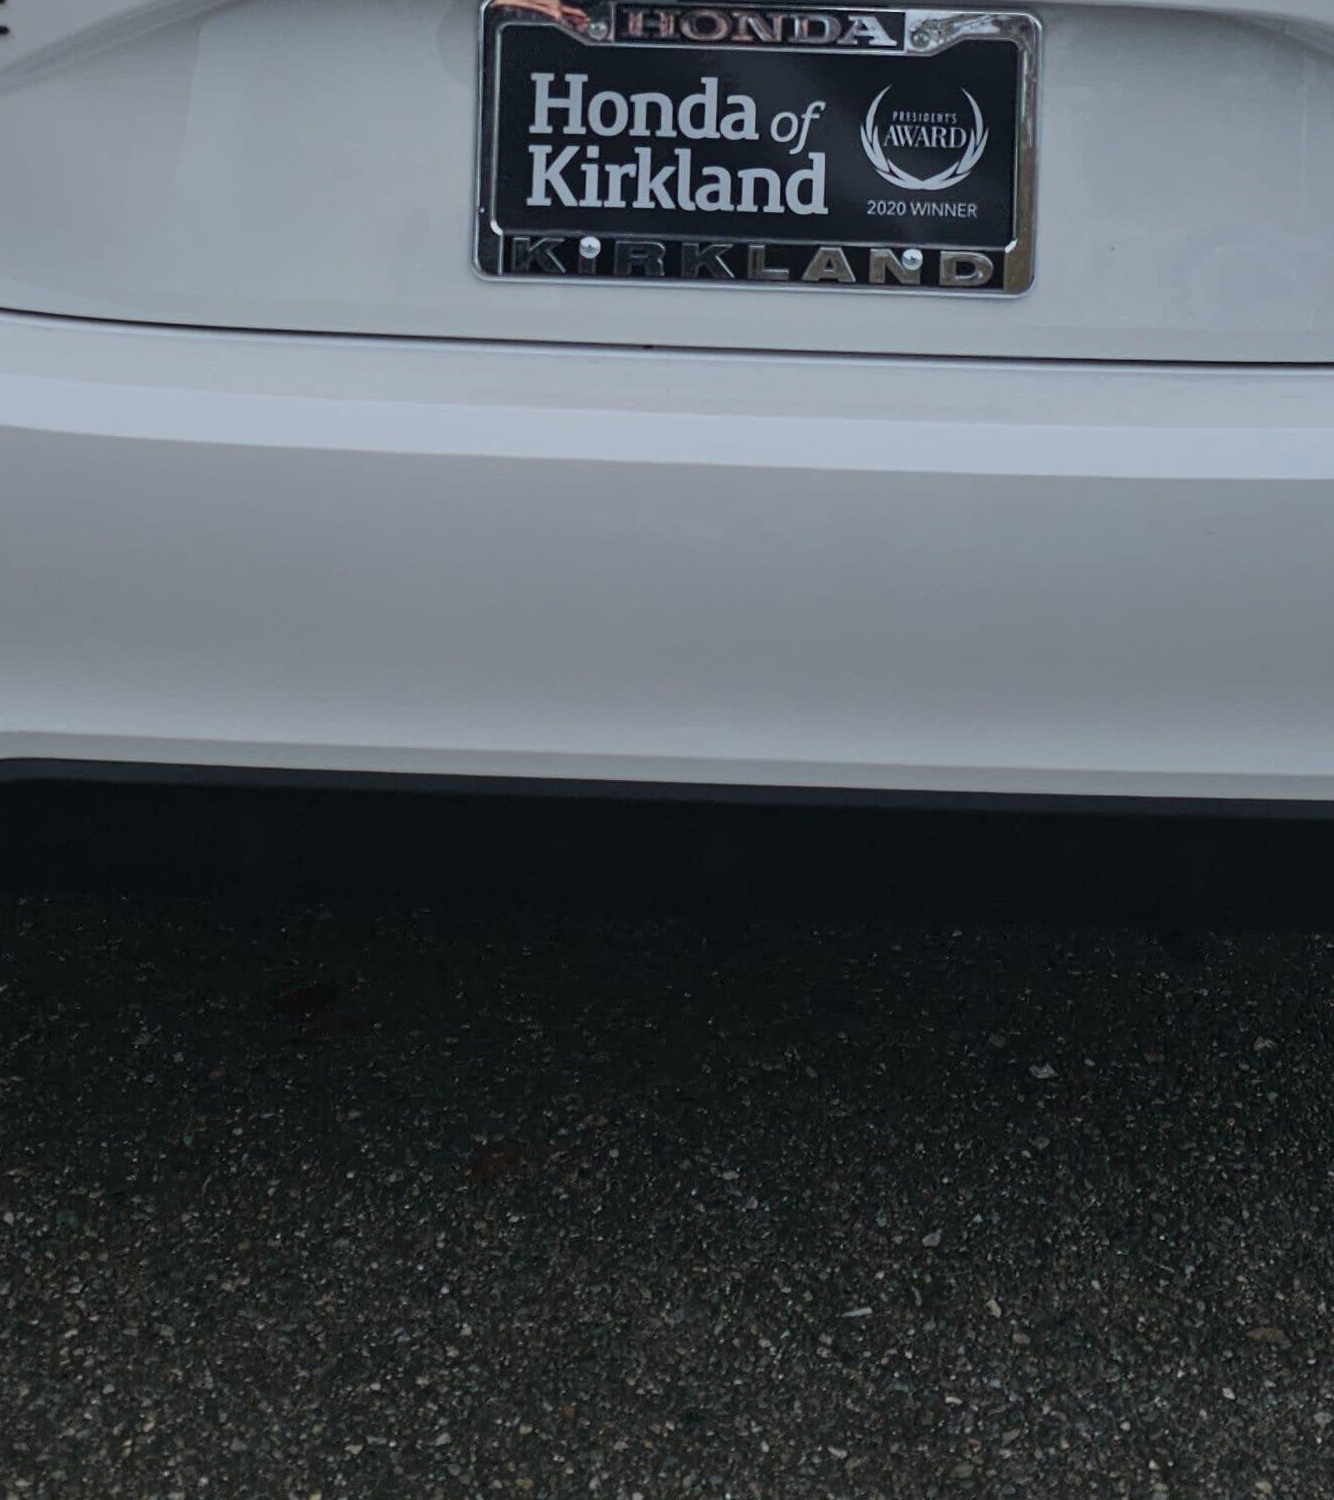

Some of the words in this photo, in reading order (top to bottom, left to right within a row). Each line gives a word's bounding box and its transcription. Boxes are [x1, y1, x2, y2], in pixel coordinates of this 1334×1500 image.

[622, 8, 898, 47] HONDA
[528, 72, 760, 141] Honda
[769, 100, 827, 155] of
[883, 124, 968, 149] AWARD
[526, 144, 829, 215] Kirkland
[866, 199, 907, 216] 2020
[910, 201, 978, 218] WINNER
